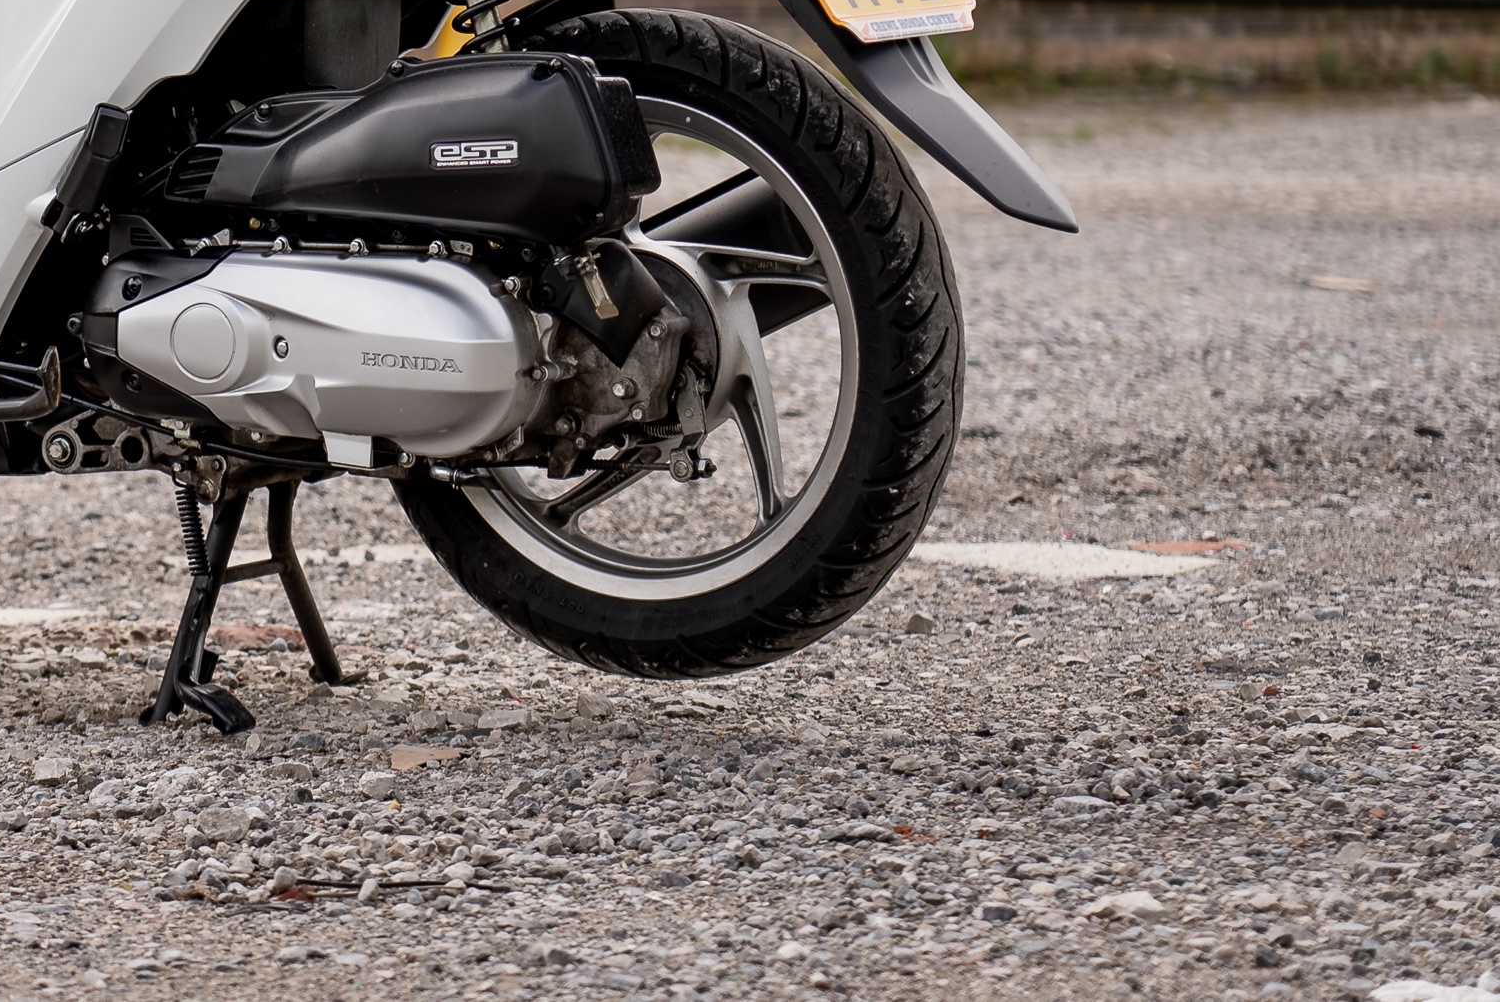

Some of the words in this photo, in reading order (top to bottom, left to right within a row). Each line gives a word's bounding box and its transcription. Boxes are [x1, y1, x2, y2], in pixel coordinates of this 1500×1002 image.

[870, 20, 899, 33] CREWE
[900, 16, 926, 30] HONDA
[926, 13, 958, 26] CENTRE
[360, 351, 463, 373] HONDA
